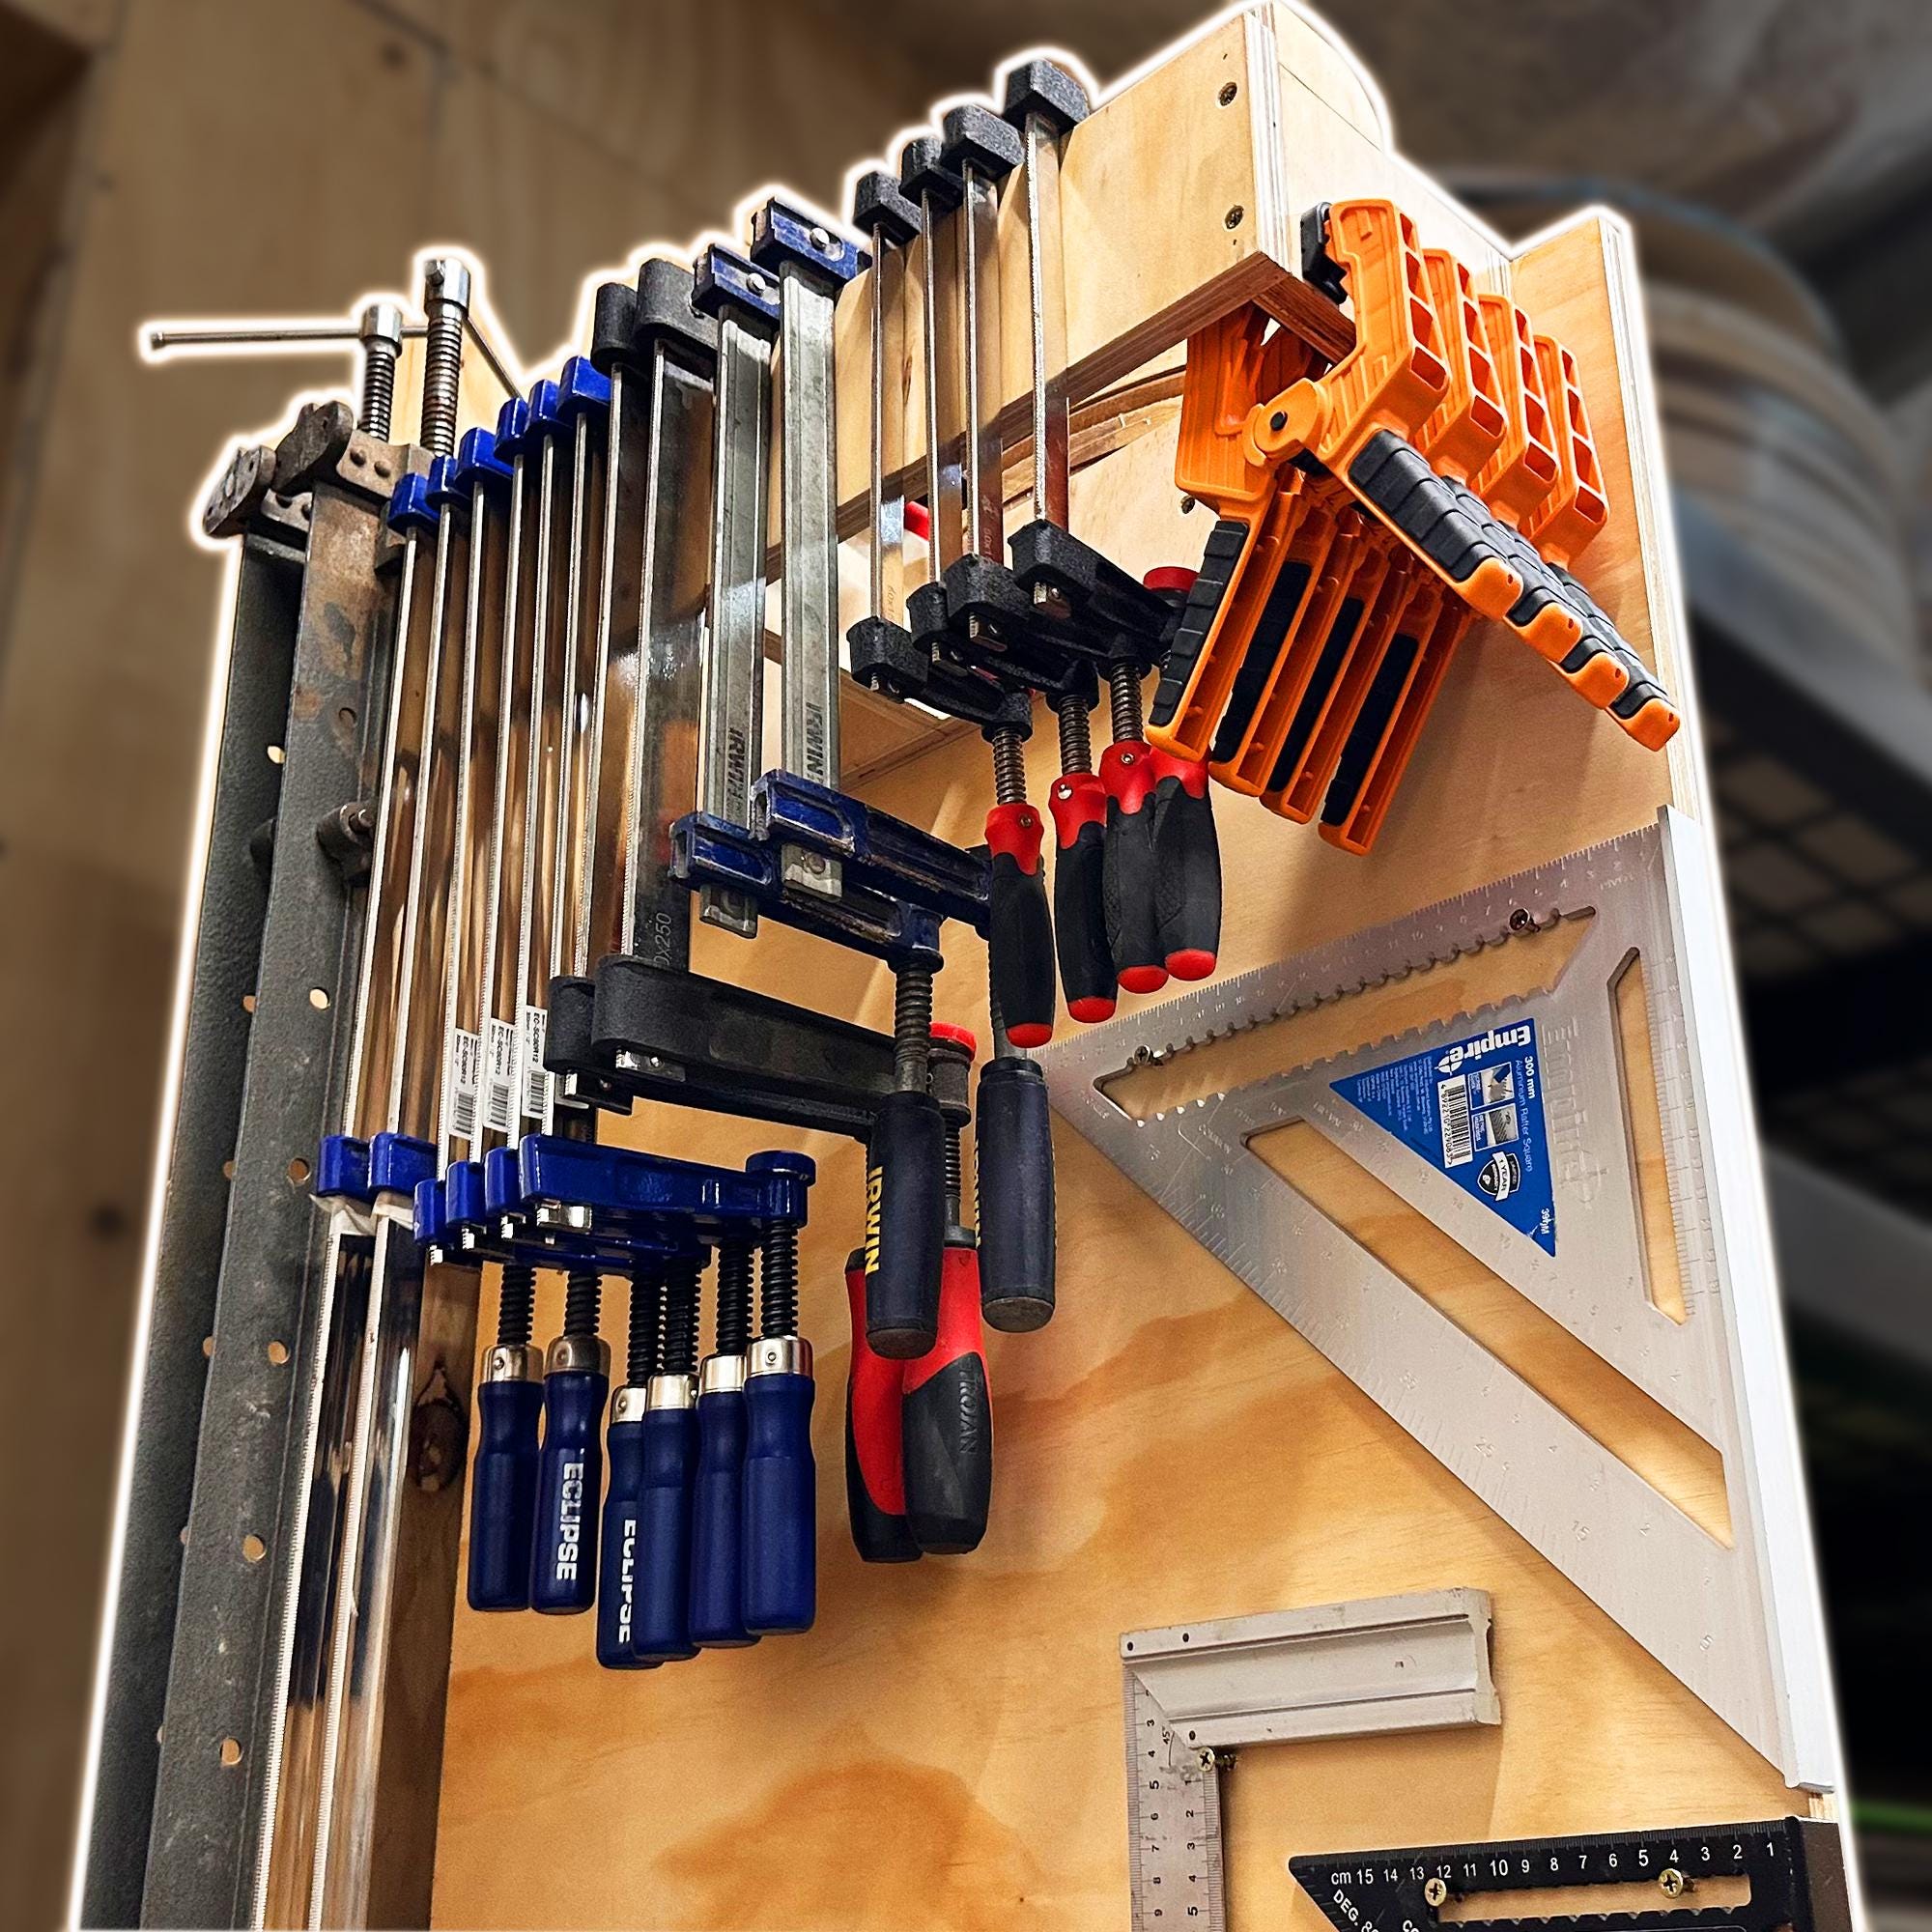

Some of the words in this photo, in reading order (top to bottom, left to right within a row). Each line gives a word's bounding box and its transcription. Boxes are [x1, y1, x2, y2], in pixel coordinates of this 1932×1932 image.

[806, 701, 824, 776] IRWIN
[1449, 1025, 1532, 1064] Empire
[1524, 1056, 1535, 1077] 300
[1527, 1079, 1536, 1099] mm
[1520, 1108, 1529, 1136] Rafter
[1499, 1165, 1509, 1192] YEAR
[866, 1166, 884, 1276] IRWIN
[555, 1463, 584, 1580] ECLIPSE
[1474, 1436, 1495, 1458] 25
[1572, 1520, 1591, 1542] 15
[1700, 1634, 1714, 1651] 5
[1149, 1779, 1159, 1790] 5
[1185, 1809, 1194, 1818] 2
[1186, 1842, 1196, 1851] 3
[1331, 1870, 1351, 1885] cm
[1356, 1868, 1374, 1885] 15
[1383, 1868, 1398, 1883] 14
[1409, 1866, 1425, 1881] 13
[1436, 1864, 1451, 1879] 12
[1463, 1863, 1477, 1877] 11
[1490, 1859, 1509, 1876] 10
[1520, 1859, 1530, 1874] 9
[1549, 1857, 1559, 1871] 8
[1578, 1855, 1588, 1869] 7
[1608, 1853, 1618, 1867] 6
[1638, 1849, 1649, 1866] 5
[1669, 1849, 1679, 1863] 4
[1701, 1846, 1711, 1861] 3
[1732, 1844, 1743, 1860] 2
[1766, 1842, 1775, 1857] 1
[1188, 1874, 1197, 1883] 4
[1187, 1906, 1198, 1917] 5
[1333, 1889, 1359, 1926] DEG.
